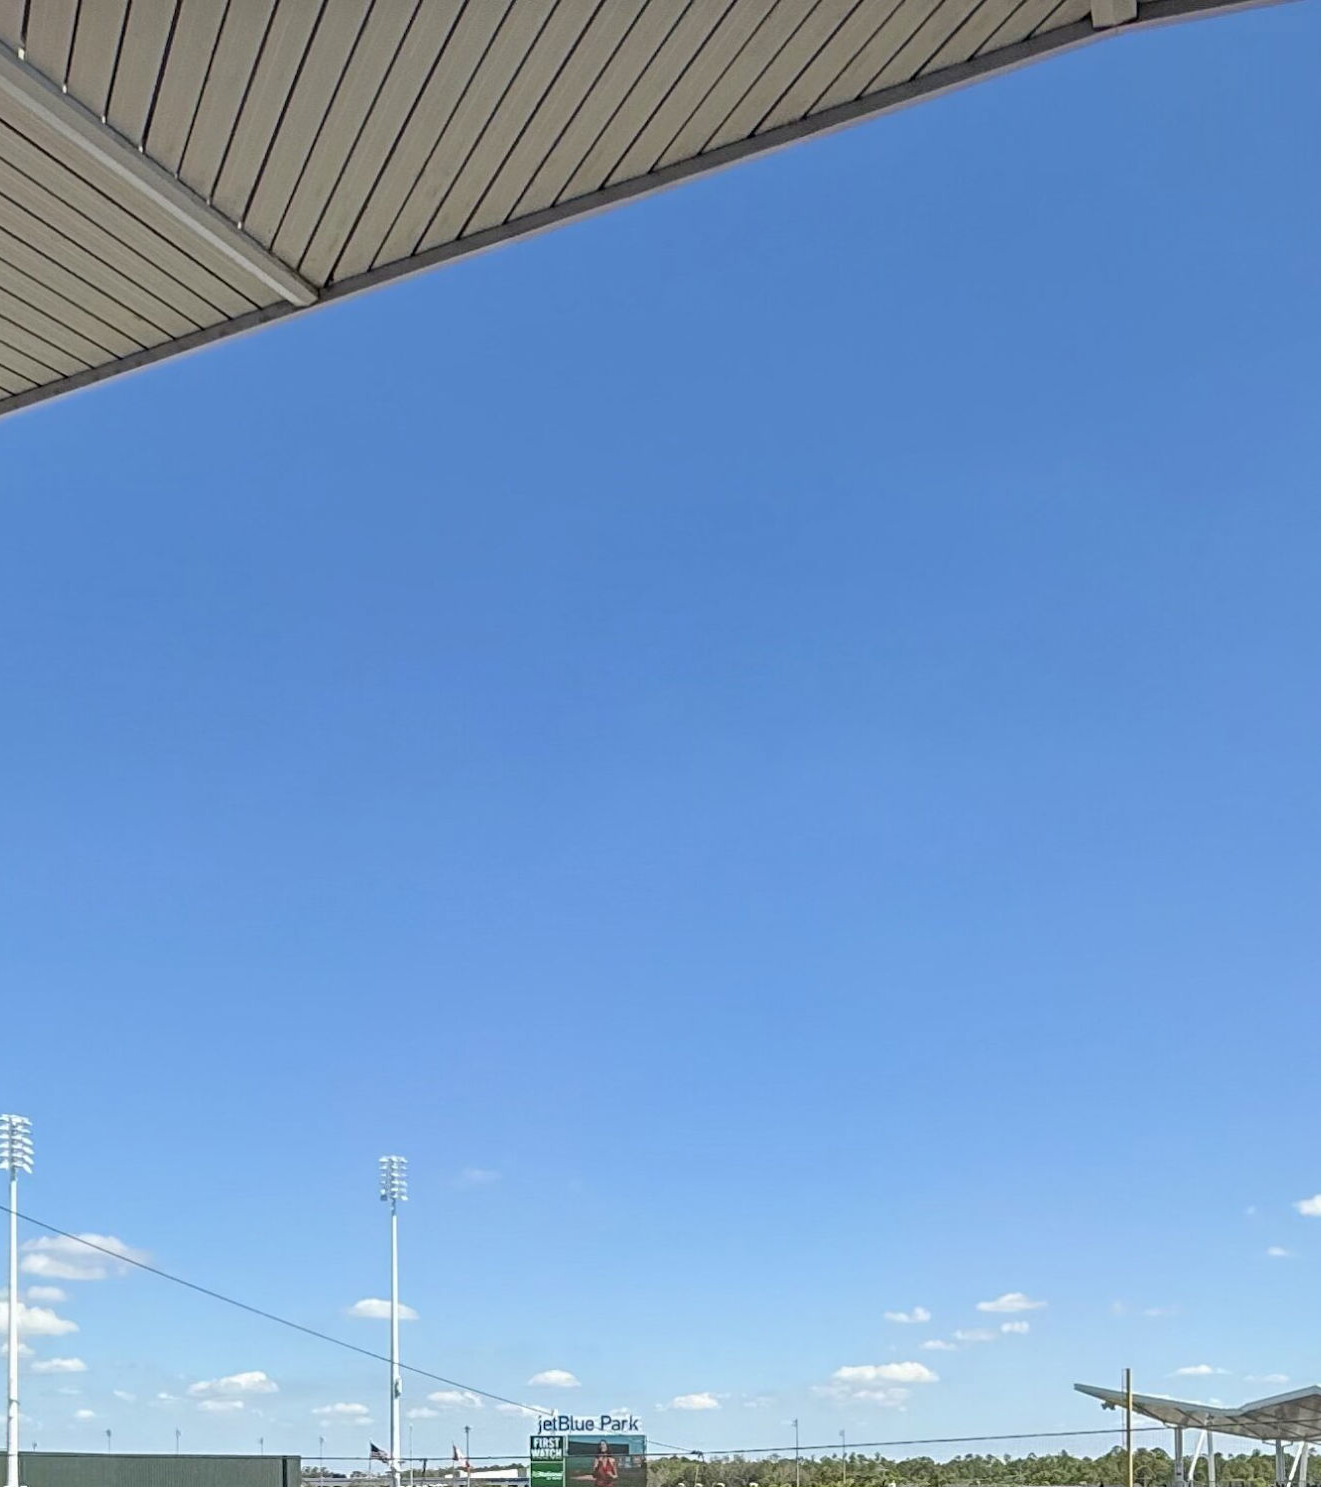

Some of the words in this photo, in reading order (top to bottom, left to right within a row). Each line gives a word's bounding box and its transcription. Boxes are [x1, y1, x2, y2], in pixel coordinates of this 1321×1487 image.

[538, 1415, 594, 1434] jetBlue
[601, 1415, 639, 1431] Park
[533, 1437, 560, 1448] FIRST
[532, 1448, 562, 1459] WATCH
